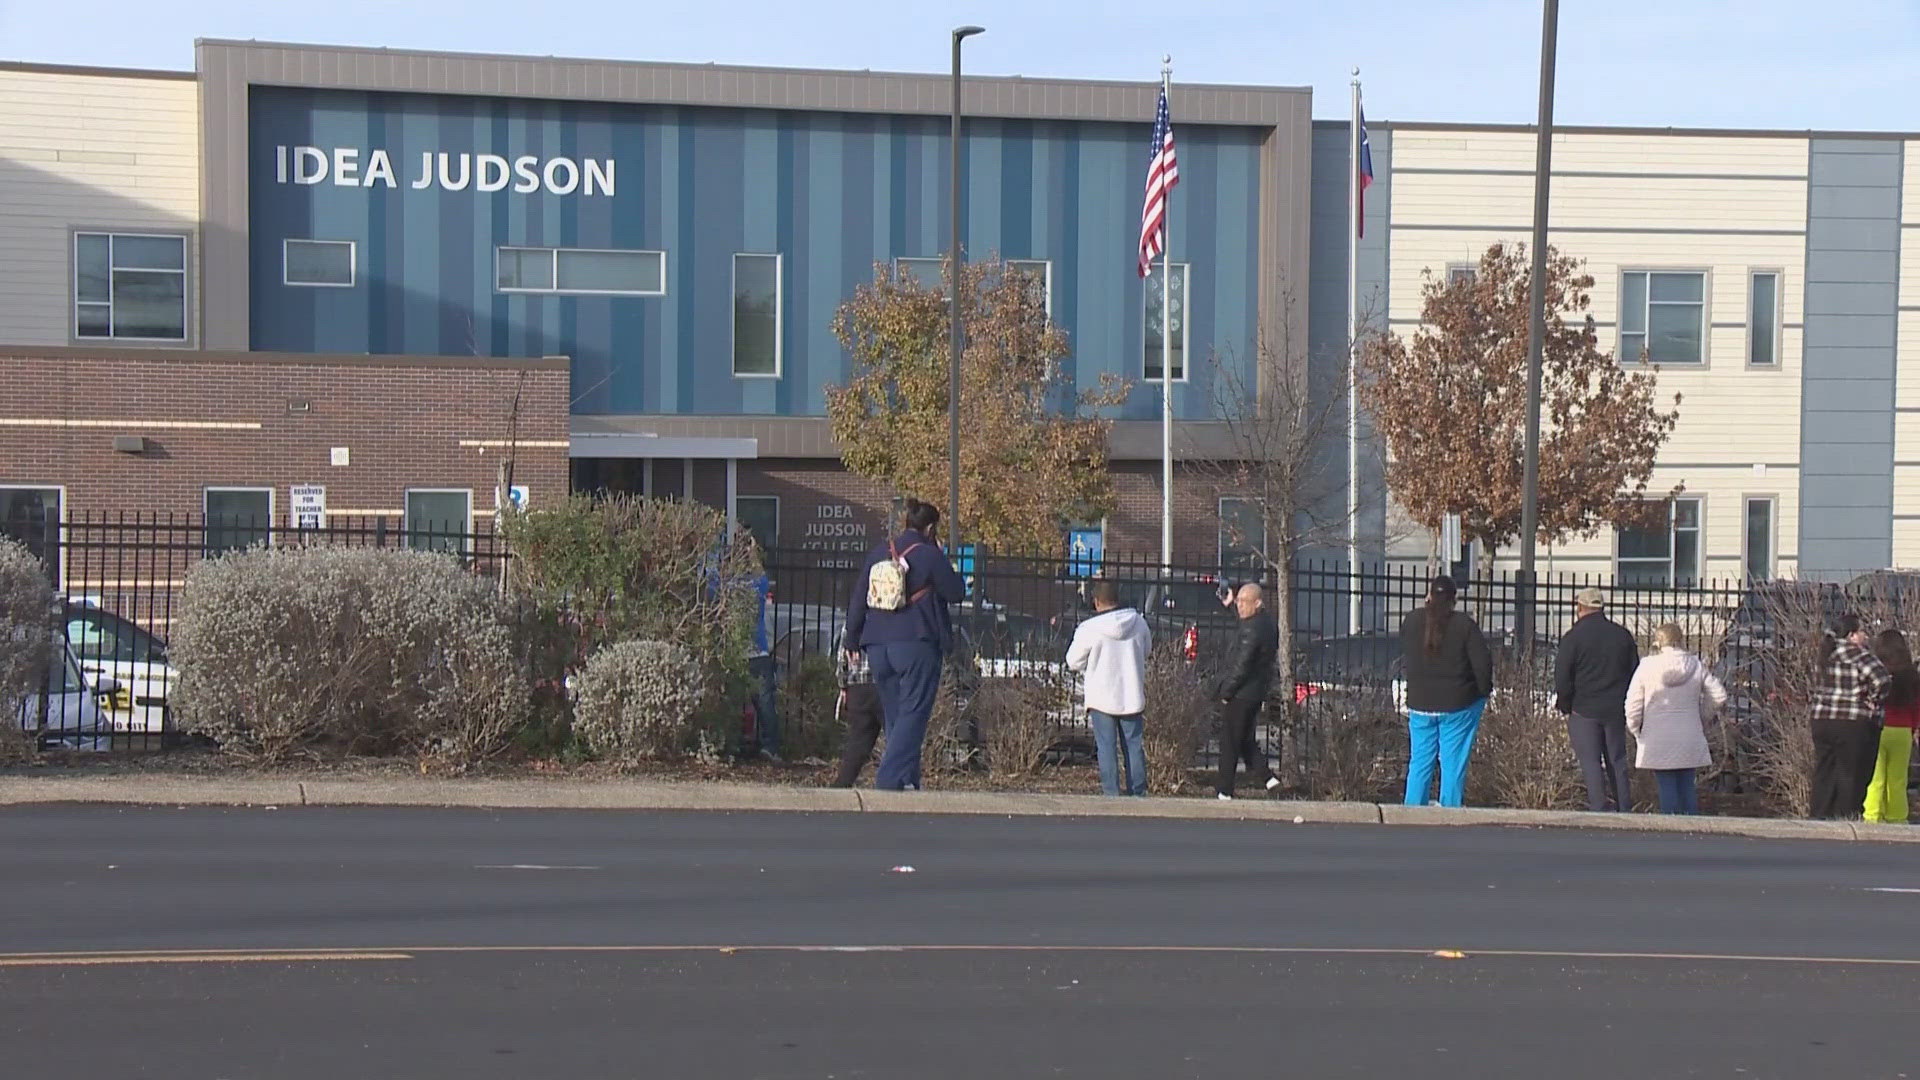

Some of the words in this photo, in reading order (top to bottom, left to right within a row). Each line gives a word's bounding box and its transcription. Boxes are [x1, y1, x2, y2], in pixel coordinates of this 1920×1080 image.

[276, 145, 397, 188] IDEA
[412, 152, 615, 196] JUDSON
[818, 505, 853, 518] IDEA
[805, 523, 866, 536] JUDSON
